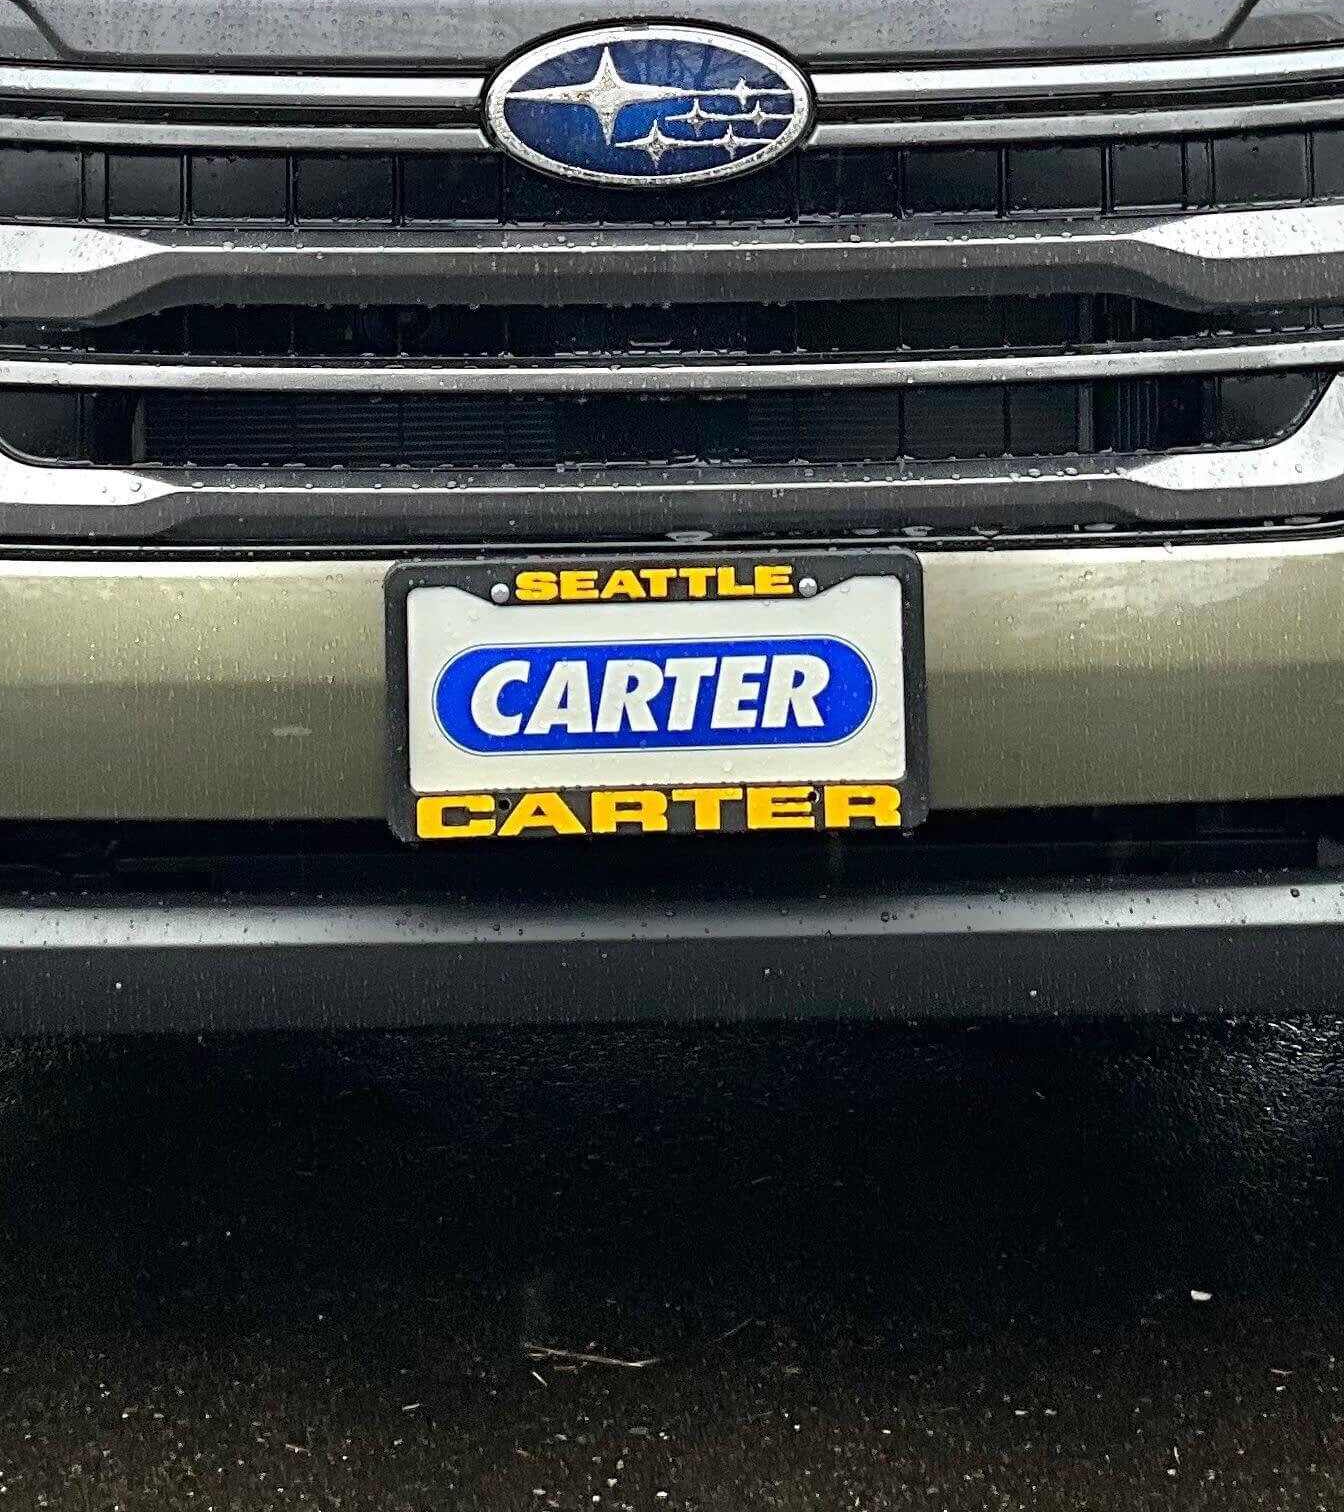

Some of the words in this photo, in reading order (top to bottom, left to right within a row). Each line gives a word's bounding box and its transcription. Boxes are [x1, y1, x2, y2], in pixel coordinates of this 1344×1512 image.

[515, 565, 794, 602] SEATTLE
[470, 654, 831, 737] CARTER
[416, 785, 902, 840] CARTER
